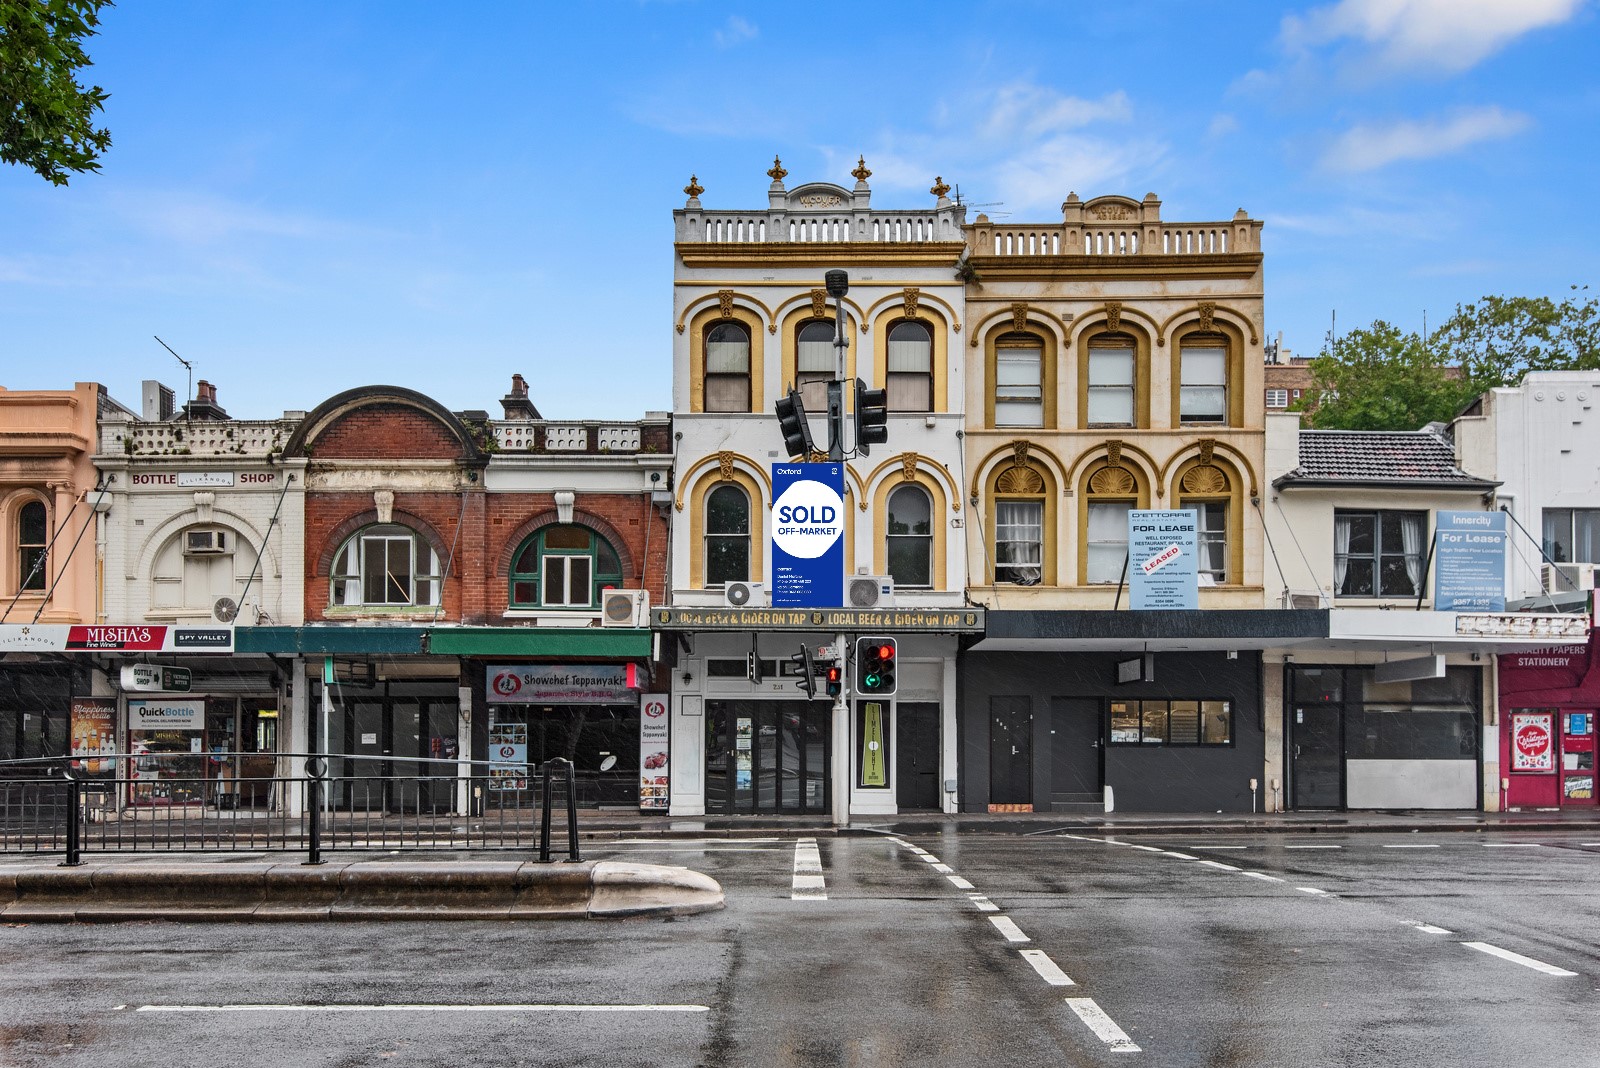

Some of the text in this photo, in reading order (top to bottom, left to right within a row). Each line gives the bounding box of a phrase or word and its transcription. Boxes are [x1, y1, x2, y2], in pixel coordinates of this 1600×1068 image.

[132, 474, 176, 484] BOTTLE
[240, 473, 275, 483] SHOP
[778, 505, 836, 524] SOLD
[1452, 515, 1491, 527] Innercity
[777, 527, 838, 536] OFF-MARKET
[1441, 533, 1501, 543] For Lease
[1144, 547, 1179, 572] LEASED
[730, 612, 739, 624] &
[741, 611, 771, 625] CIDER
[772, 612, 786, 625] ON
[788, 612, 806, 625] TAP
[828, 612, 857, 625] LOCAL
[858, 612, 882, 625] BEER
[883, 612, 892, 625] &
[86, 626, 151, 643] MISHA'S
[0, 637, 55, 646] ILIKANOON
[1514, 645, 1586, 655] ALITY PAPERS
[1518, 657, 1570, 667] STATIONERY
[133, 668, 153, 677] BOTTLE
[136, 678, 150, 686] SHOP
[524, 674, 623, 687] Showchef Teppanyaki
[534, 690, 570, 699] Japanese
[570, 690, 591, 698] Style
[73, 704, 116, 714] Happiness
[138, 706, 195, 717] QuickBottle
[643, 723, 666, 731] Showchef
